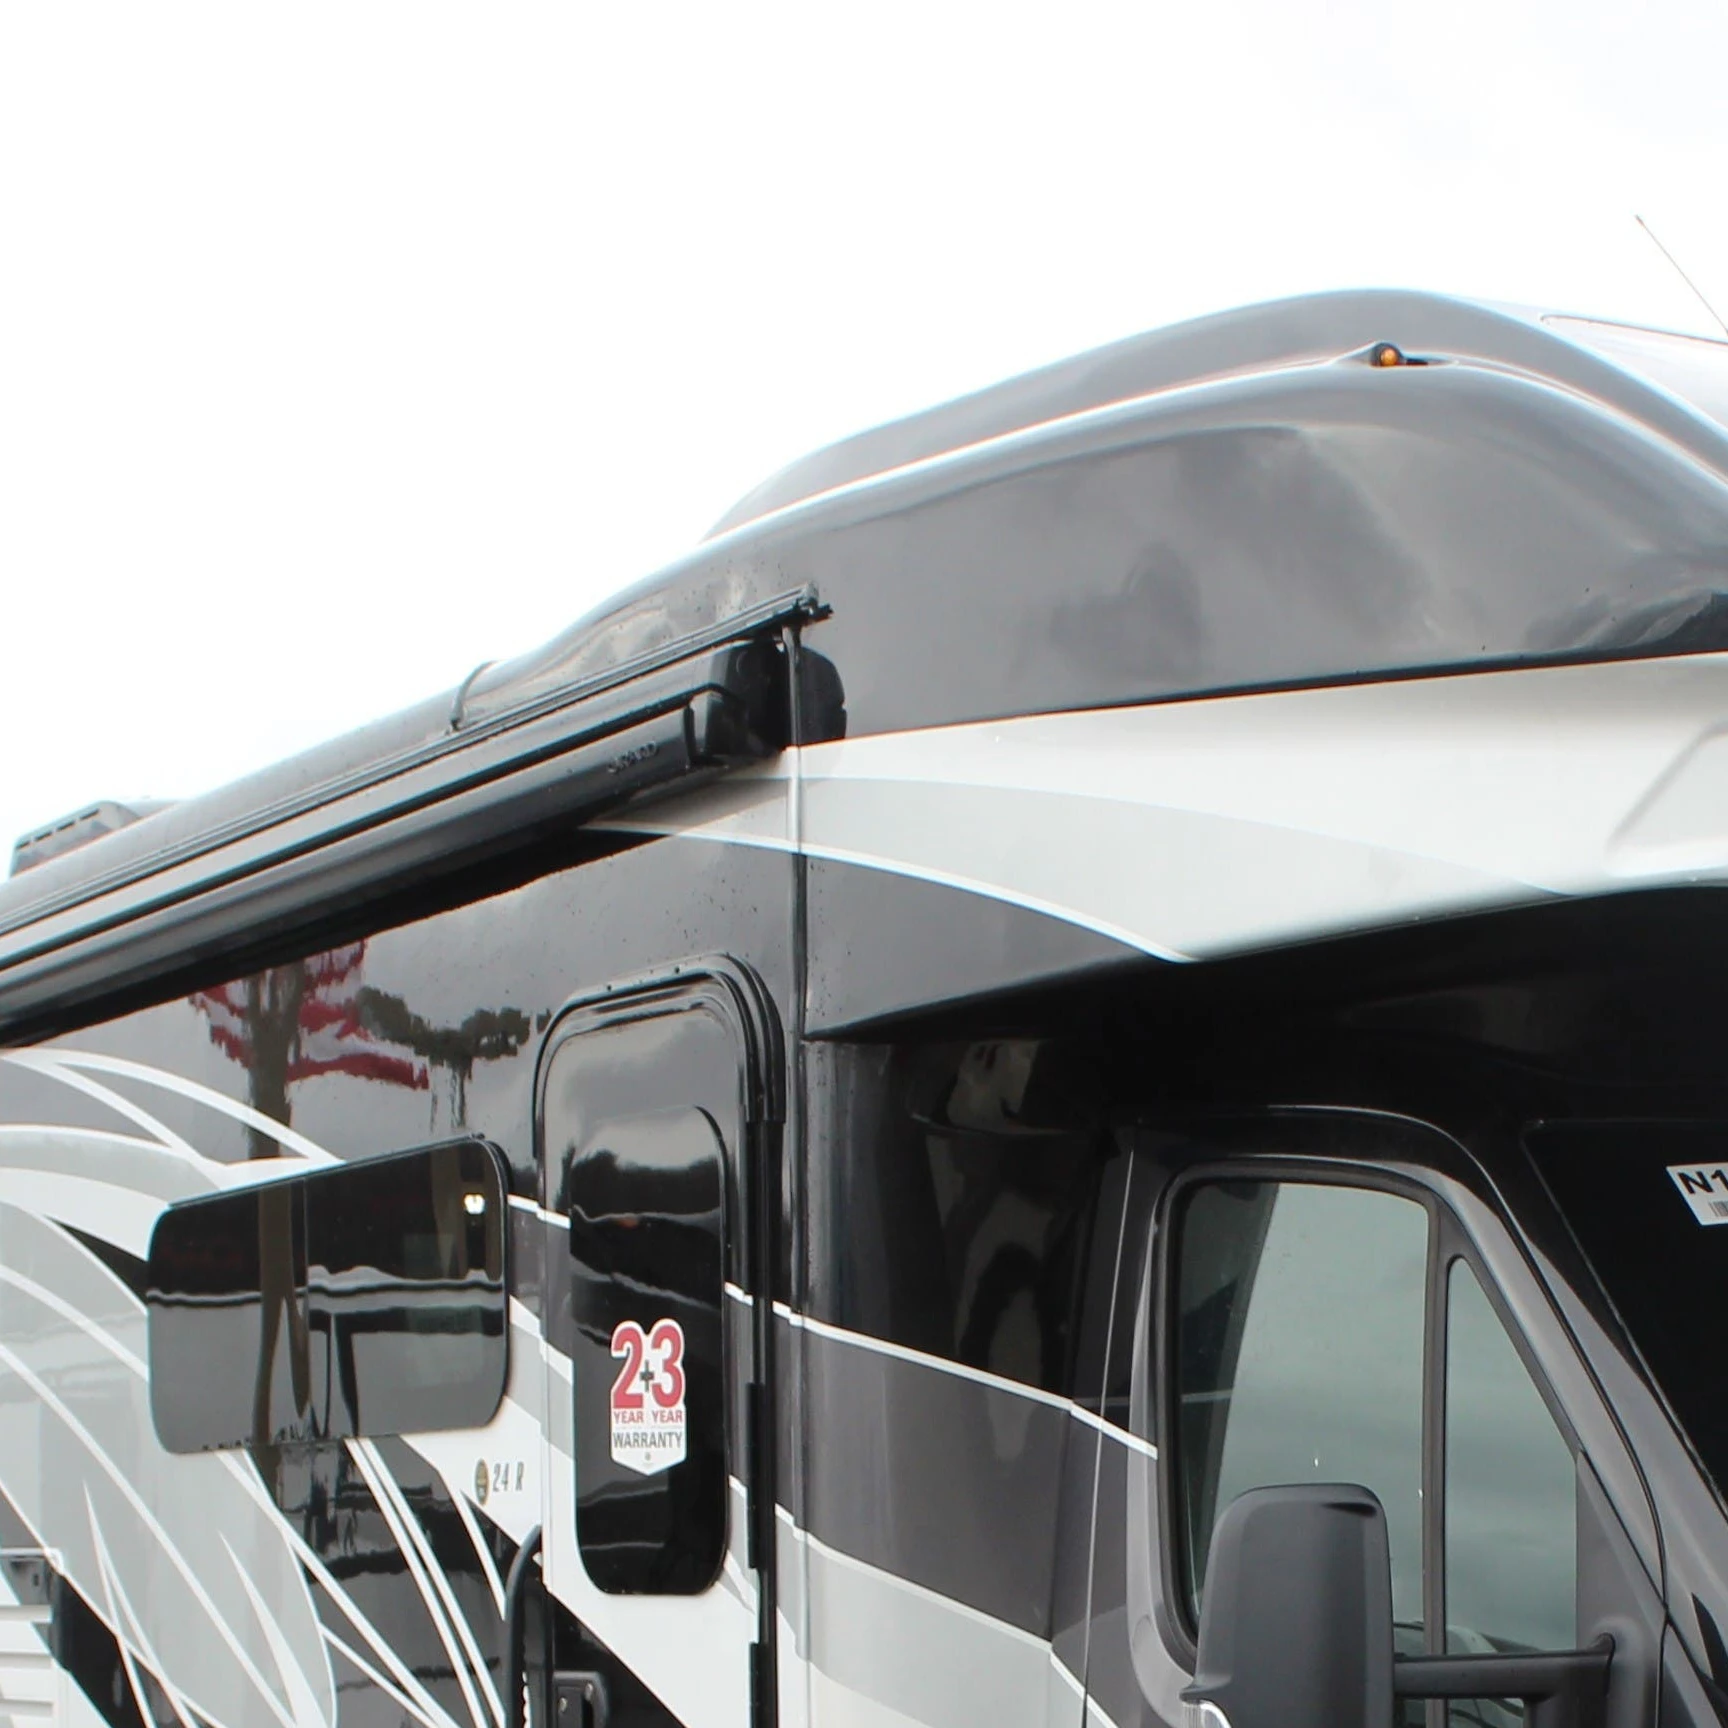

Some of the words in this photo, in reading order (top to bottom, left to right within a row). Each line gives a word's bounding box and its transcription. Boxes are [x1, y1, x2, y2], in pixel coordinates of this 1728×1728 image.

[613, 1410, 644, 1424] YEAR
[652, 1409, 683, 1424] YEAR
[612, 1431, 683, 1449] WARRANTY
[492, 1462, 509, 1492] 24
